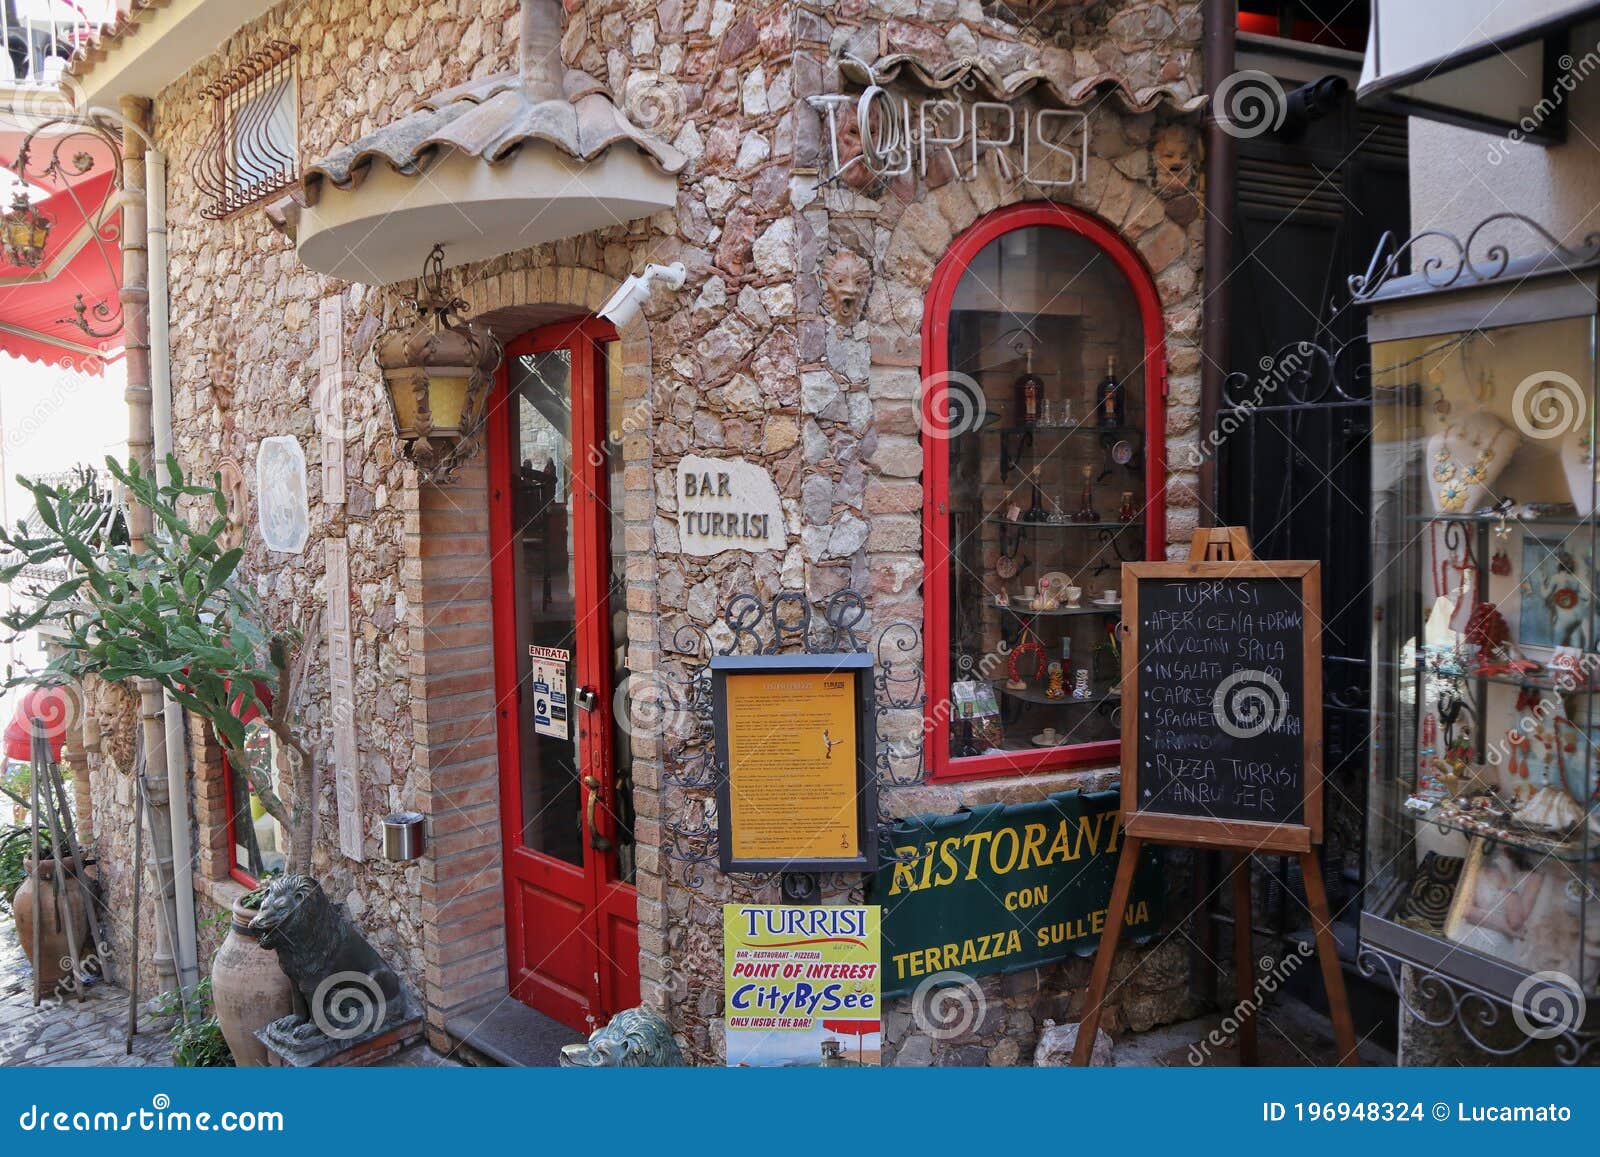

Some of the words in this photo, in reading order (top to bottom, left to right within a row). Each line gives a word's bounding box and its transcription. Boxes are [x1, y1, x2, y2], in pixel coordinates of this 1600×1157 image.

[684, 471, 732, 498] BAR
[682, 510, 769, 539] TURRISI
[1164, 581, 1260, 606] TURRISI
[530, 646, 568, 659] ENTRATA
[1221, 757, 1298, 789] TURRISI
[888, 810, 1121, 896] RISTORANT
[1004, 884, 1049, 912] CON
[740, 908, 868, 937] TURRISI
[892, 928, 1023, 980] TERRAZZA
[1036, 900, 1151, 948] SULL'ENA
[736, 951, 749, 959] BAR
[753, 951, 790, 960] RESTAURANT
[793, 952, 821, 960] PIZZERIA
[732, 962, 780, 979] POINT
[782, 963, 804, 979] OF
[805, 963, 877, 980] INTEREST
[731, 982, 874, 1015] CityBySee
[730, 1017, 750, 1028] ONLY
[750, 1017, 776, 1028] INSIDE
[777, 1017, 791, 1028] THE
[792, 1018, 812, 1028] BAR!
